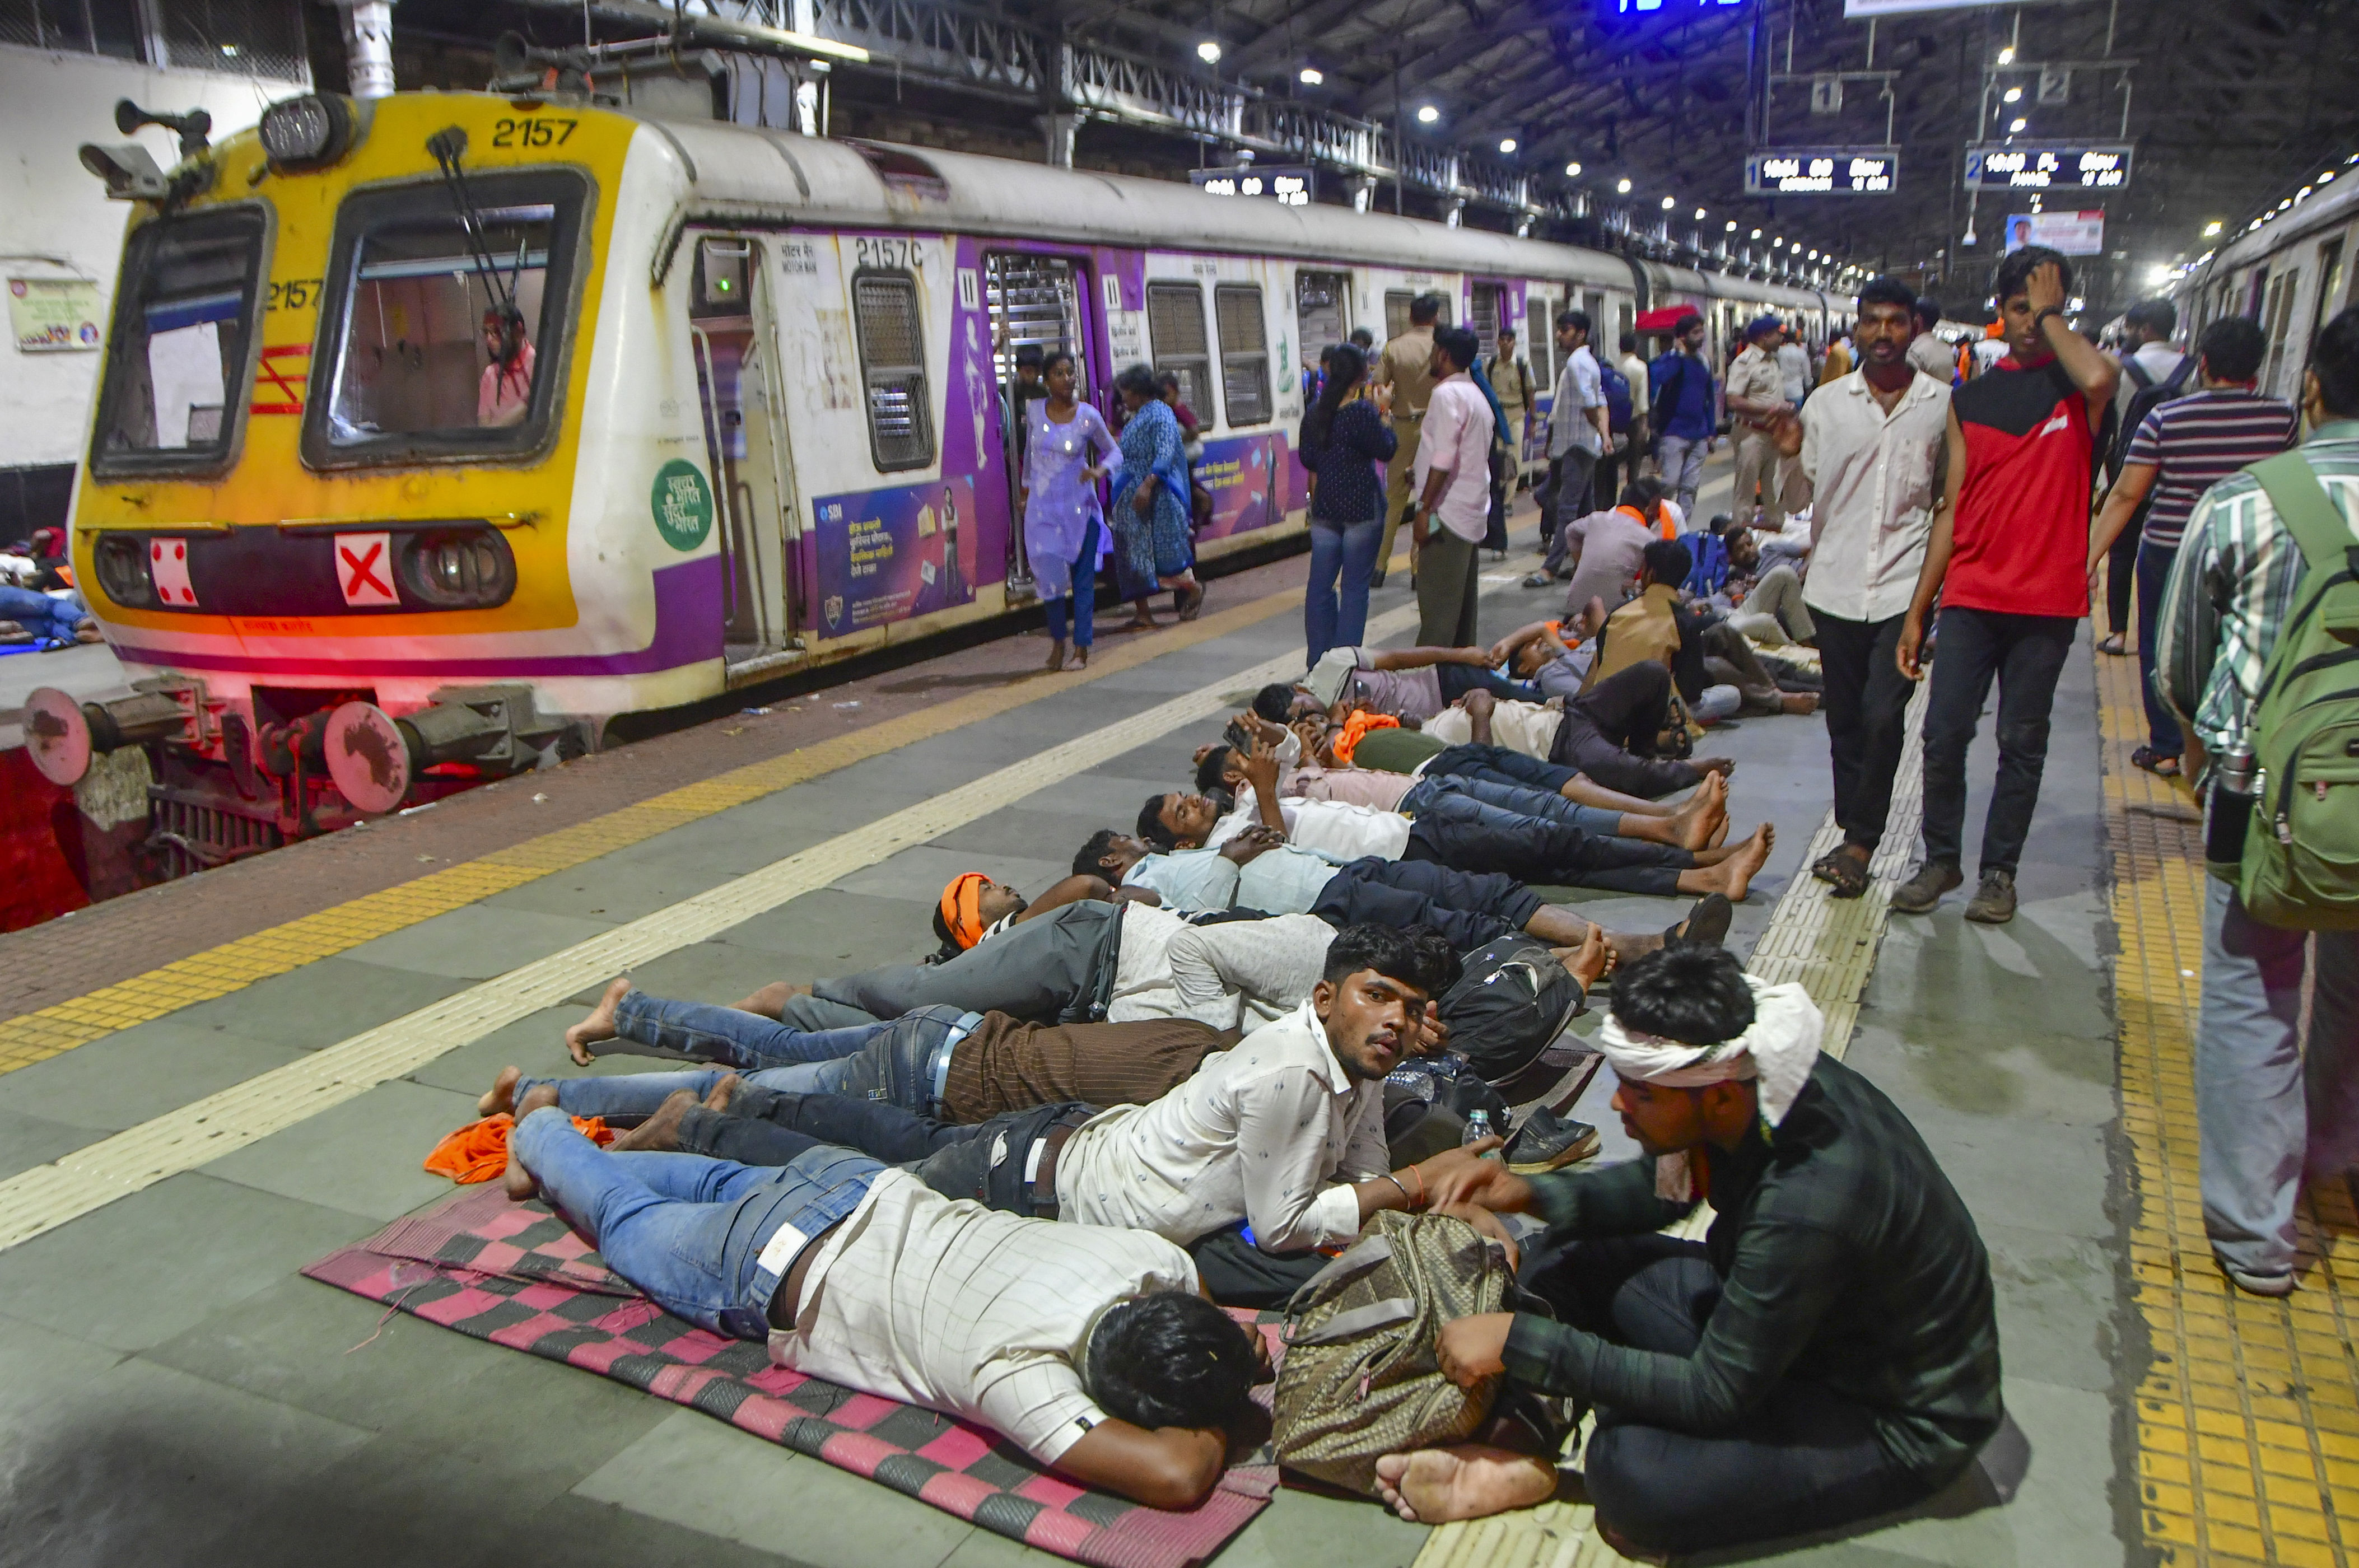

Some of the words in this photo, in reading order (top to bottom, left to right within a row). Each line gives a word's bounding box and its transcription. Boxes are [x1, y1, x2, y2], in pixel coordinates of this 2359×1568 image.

[1818, 82, 1832, 108] 1
[492, 118, 579, 147] 2157
[1747, 162, 1757, 185] 1
[1968, 155, 1982, 178] 2
[856, 237, 923, 269] 2157C
[782, 260, 803, 273] MOTOR
[266, 279, 324, 310] 2157
[676, 488, 701, 505] भारत
[675, 515, 700, 533] भारत
[828, 503, 842, 522] SBI
